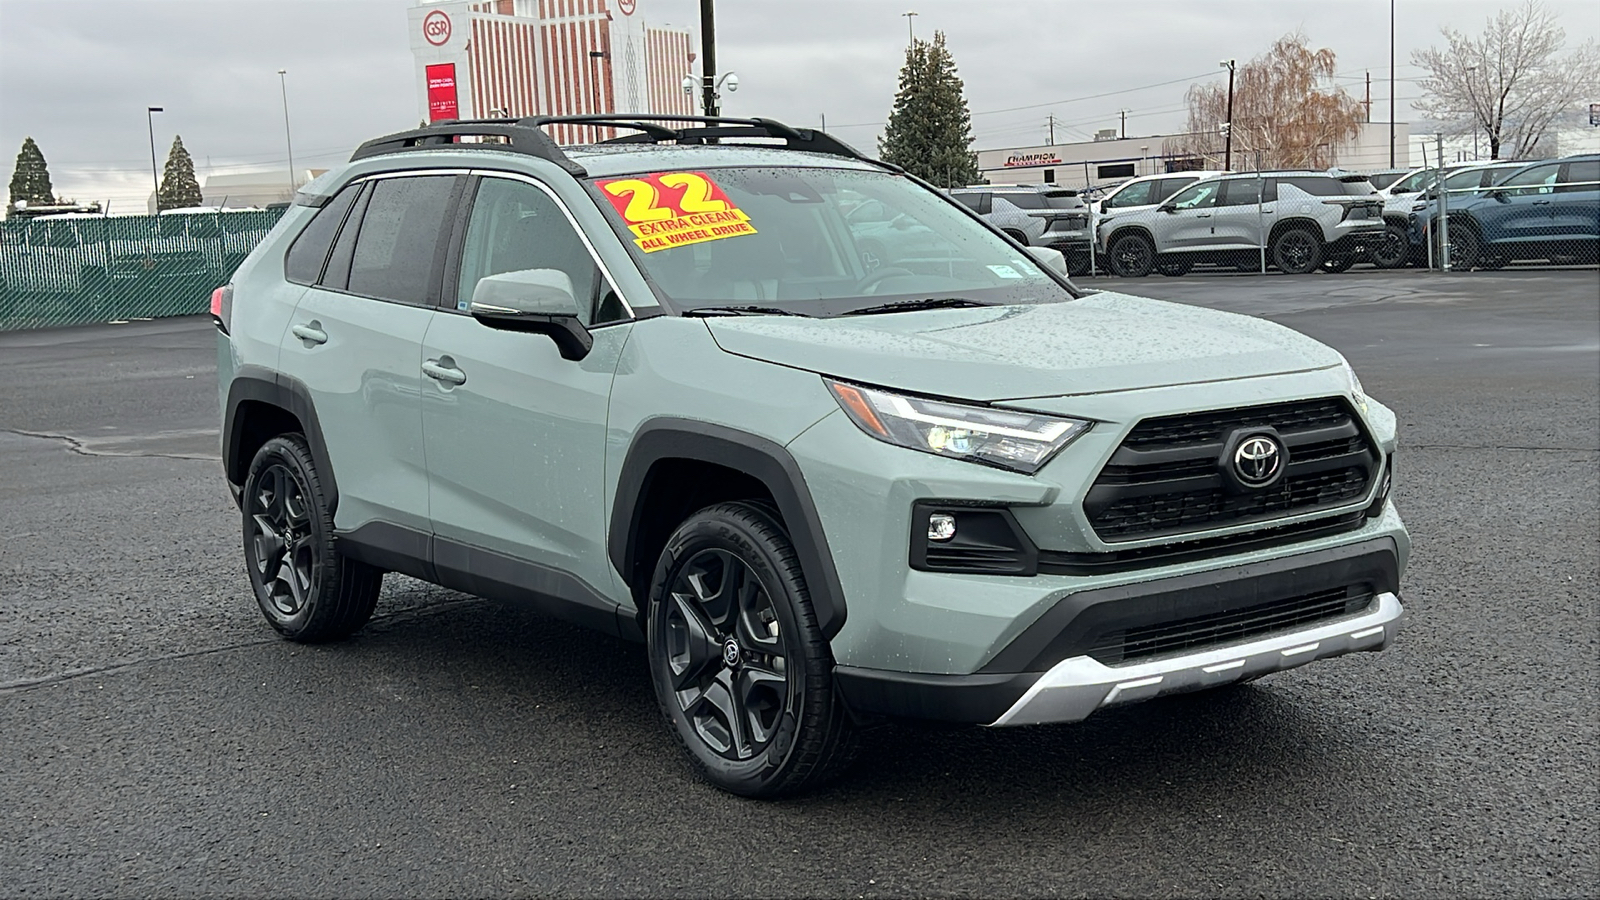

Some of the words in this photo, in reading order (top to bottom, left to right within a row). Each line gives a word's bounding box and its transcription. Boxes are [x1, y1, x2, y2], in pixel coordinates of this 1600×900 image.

[427, 20, 447, 36] GSR
[1008, 153, 1055, 163] CHAMPION
[604, 173, 729, 222] 22
[639, 217, 689, 235] EXTRA
[690, 211, 738, 226] CLEAN
[642, 239, 667, 249] ALL
[666, 231, 710, 244] WHEEL
[713, 224, 750, 236] DRIVE
